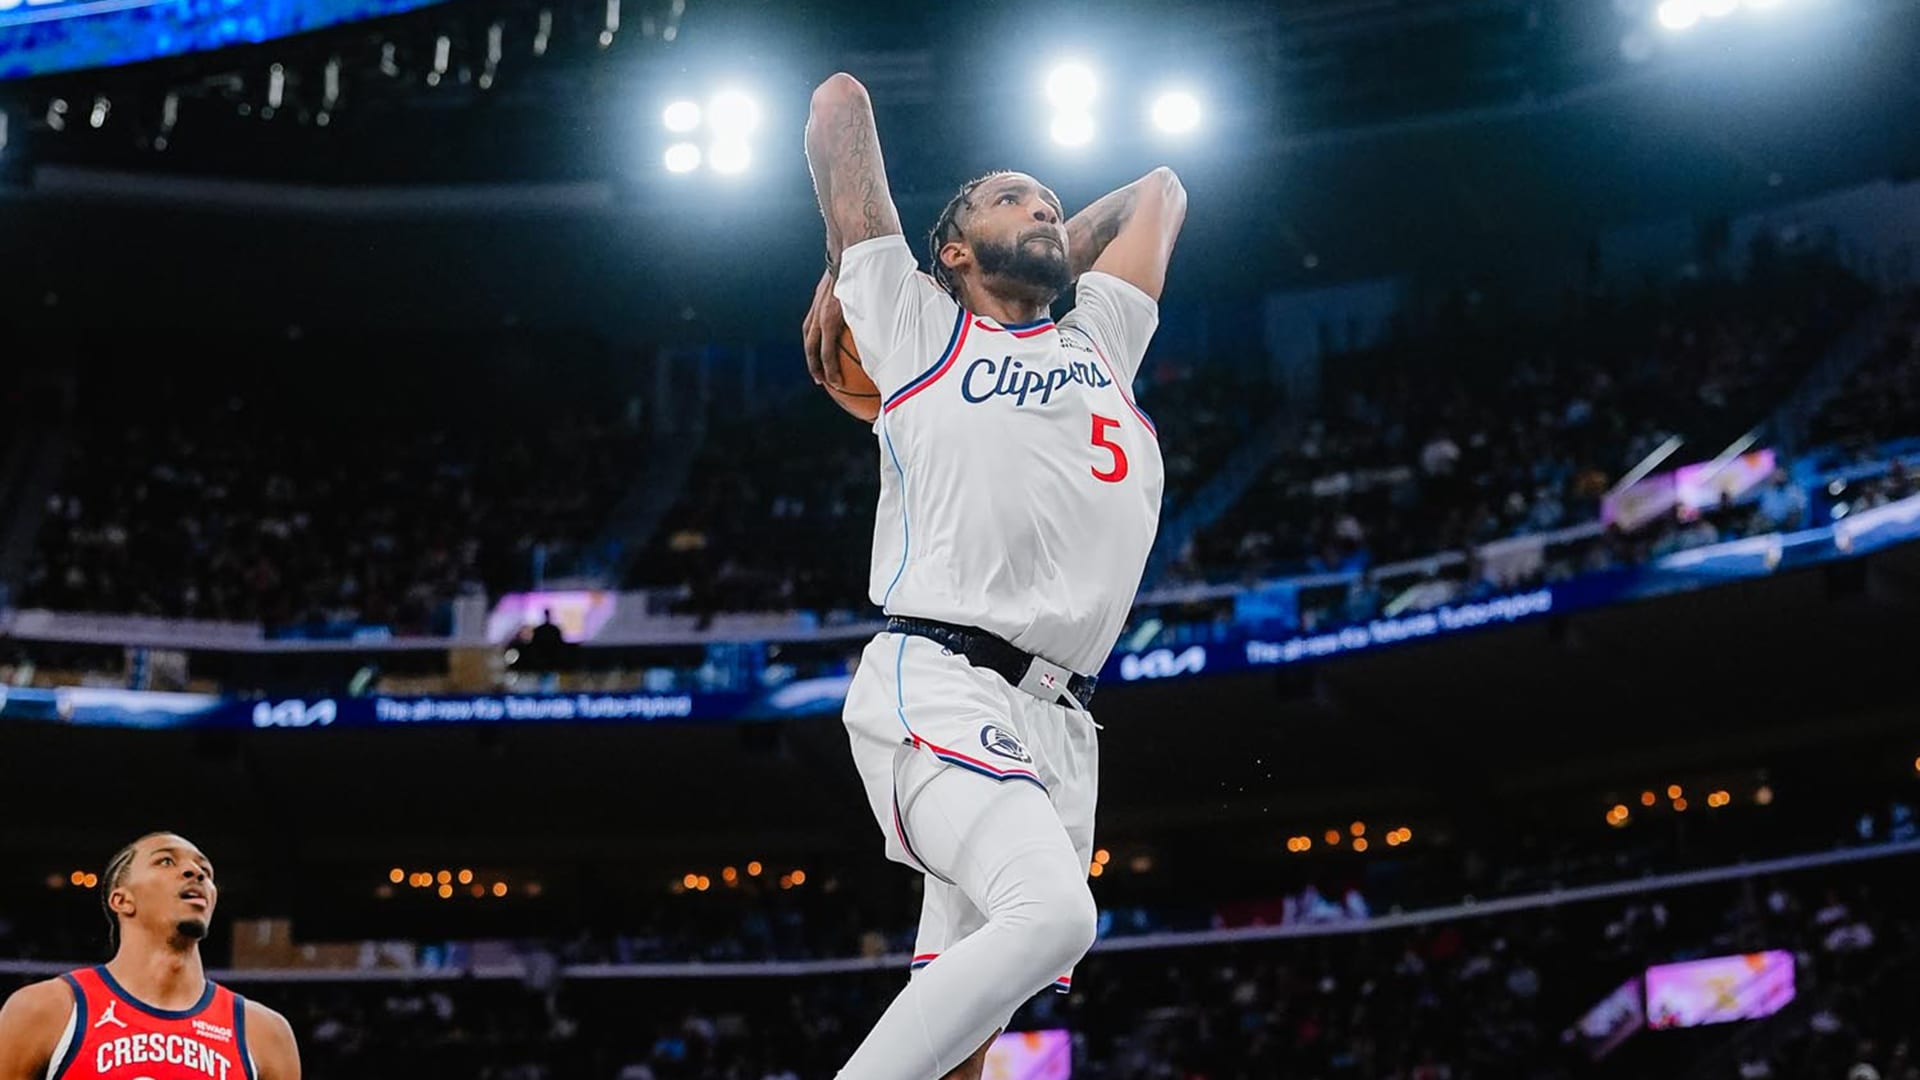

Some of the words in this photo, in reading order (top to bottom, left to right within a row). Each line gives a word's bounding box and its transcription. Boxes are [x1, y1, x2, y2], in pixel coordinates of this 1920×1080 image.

[961, 356, 1112, 406] Clippers
[1091, 413, 1128, 482] 5
[96, 1033, 231, 1080] CRESCENT
